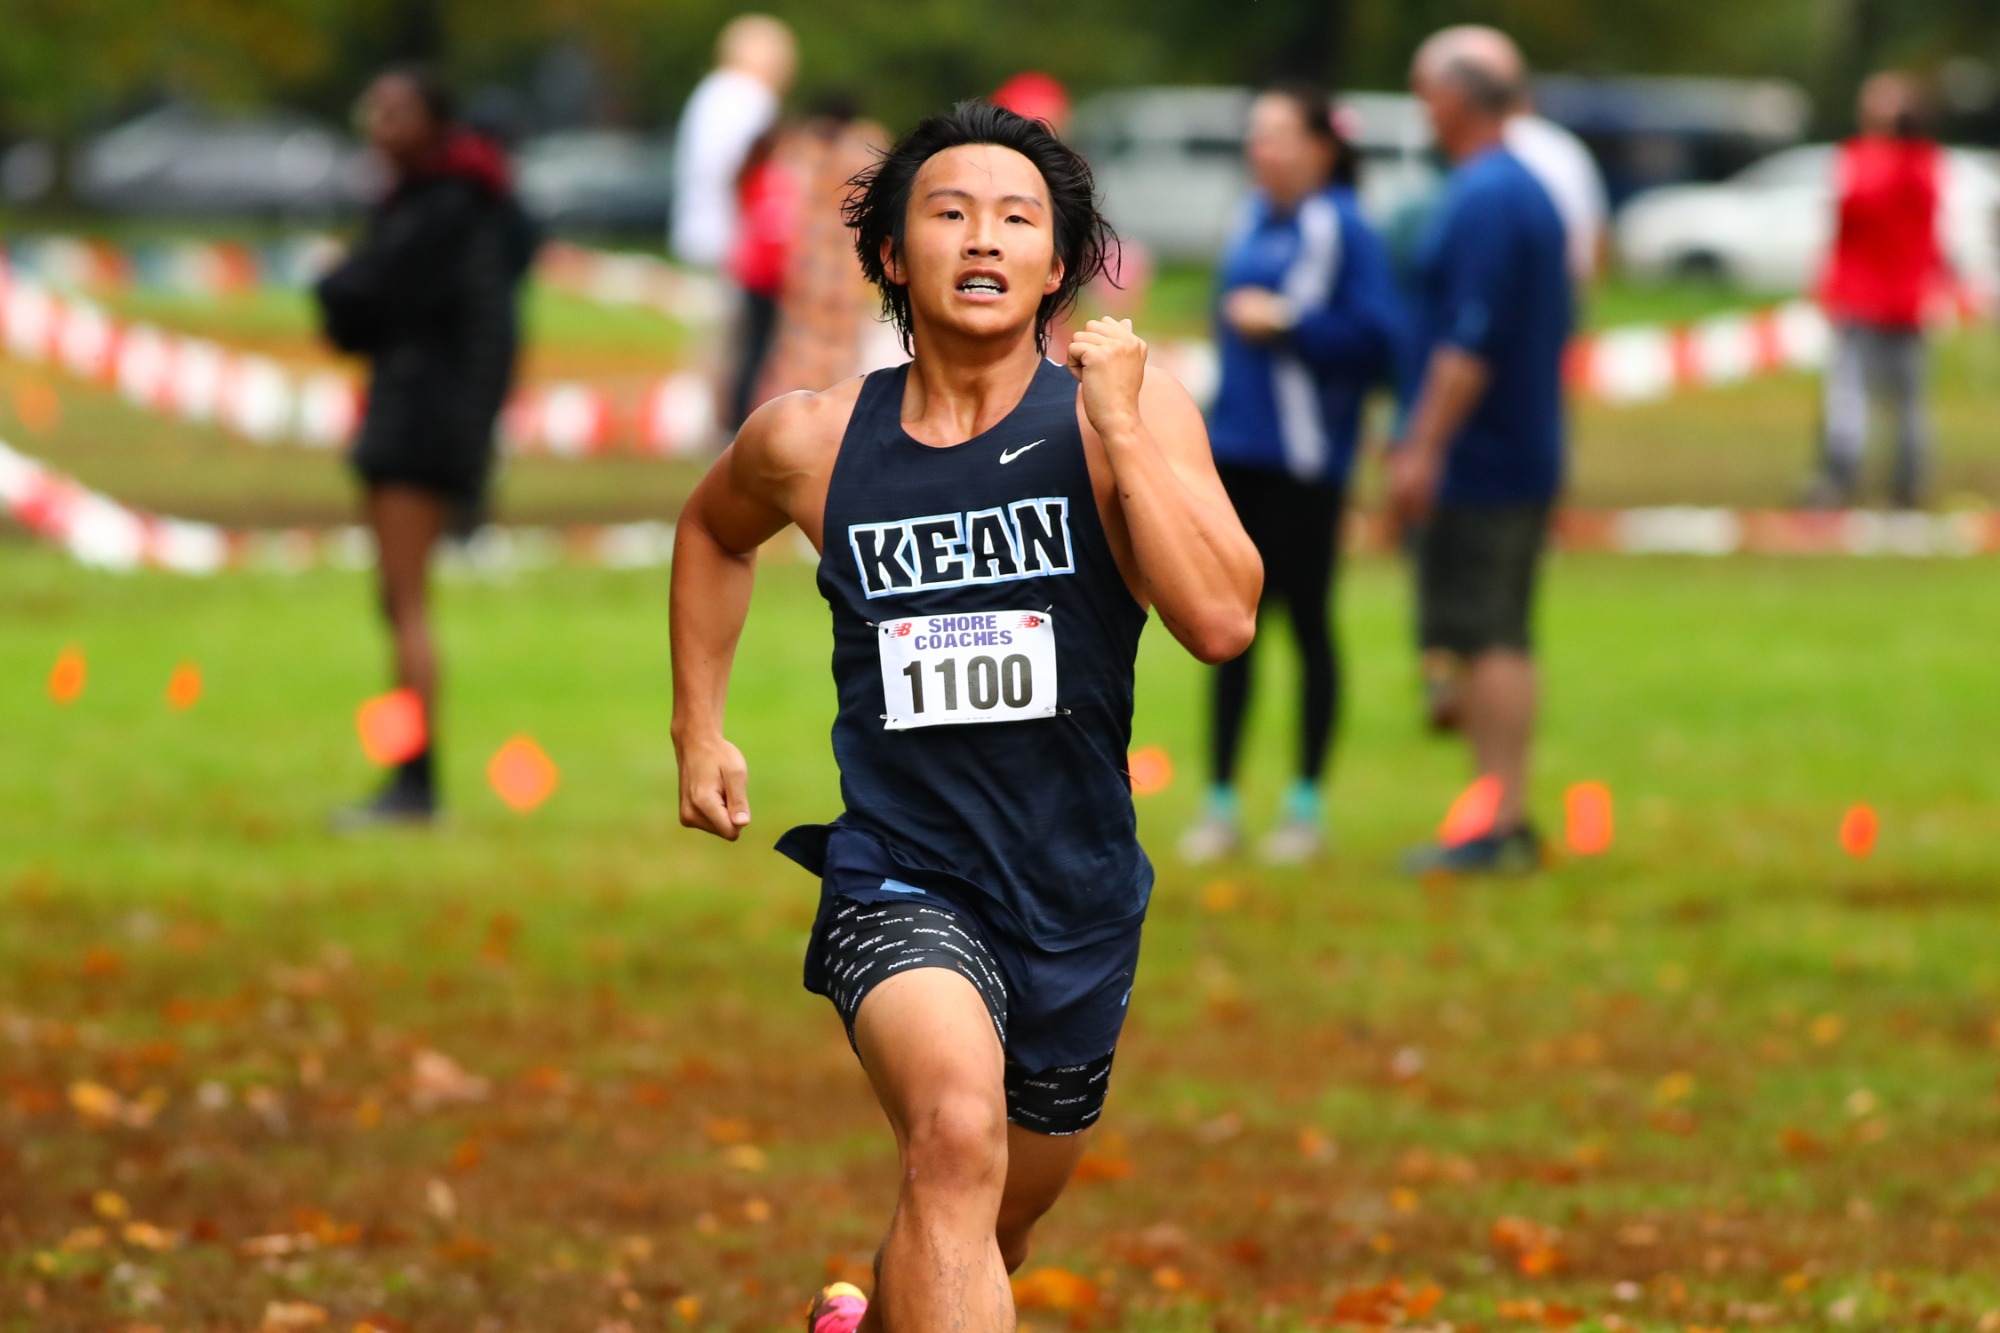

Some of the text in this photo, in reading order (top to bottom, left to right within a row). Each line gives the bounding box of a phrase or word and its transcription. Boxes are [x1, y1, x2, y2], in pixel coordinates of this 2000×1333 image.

[849, 497, 1075, 600] KEAN
[928, 615, 997, 633] SHORE
[914, 630, 1013, 650] COACHES
[902, 654, 1033, 714] 1100
[912, 928, 950, 937] NIKE
[857, 935, 884, 951] NIKE
[874, 940, 908, 953] NIKE
[940, 941, 973, 962] NIKE
[888, 957, 925, 970] NIKE
[1056, 1064, 1088, 1073] NIKE
[1024, 1080, 1060, 1090] NIKE
[1053, 1095, 1088, 1105] NIKE
[1016, 1107, 1051, 1122] NIKE
